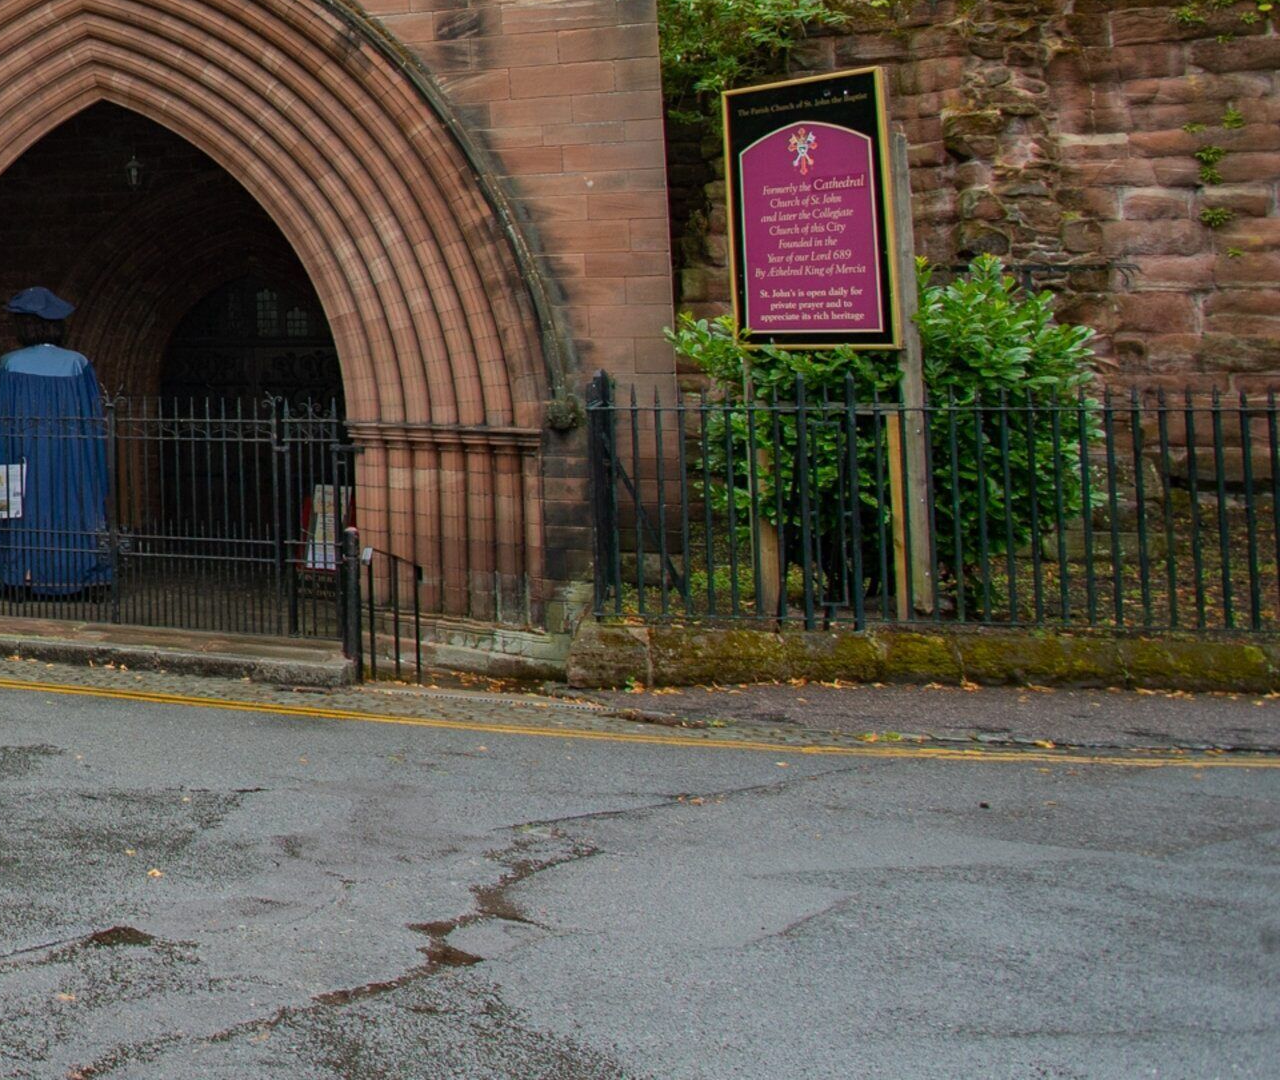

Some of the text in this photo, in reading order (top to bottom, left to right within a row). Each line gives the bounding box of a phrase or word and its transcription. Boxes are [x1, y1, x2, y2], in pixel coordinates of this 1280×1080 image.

[751, 106, 769, 115] Parish
[771, 103, 794, 112] Church
[796, 100, 803, 109] of
[815, 98, 830, 106] John
[844, 93, 867, 102] Baptist
[763, 174, 864, 195] Formerly the Cathedral
[770, 197, 800, 209] Church
[801, 195, 810, 207] of
[823, 193, 842, 204] John
[761, 208, 854, 223] and later the Collegiate
[769, 221, 846, 236] Church of this City
[778, 236, 837, 249] Founded in the
[768, 249, 851, 264] Year of our Lord 689
[755, 264, 865, 279] By Æthelred King of Mercia
[760, 286, 863, 299] St. John's is open daily for
[770, 299, 852, 311] private prayer and to
[761, 311, 864, 321] appreciate its rich heritage
